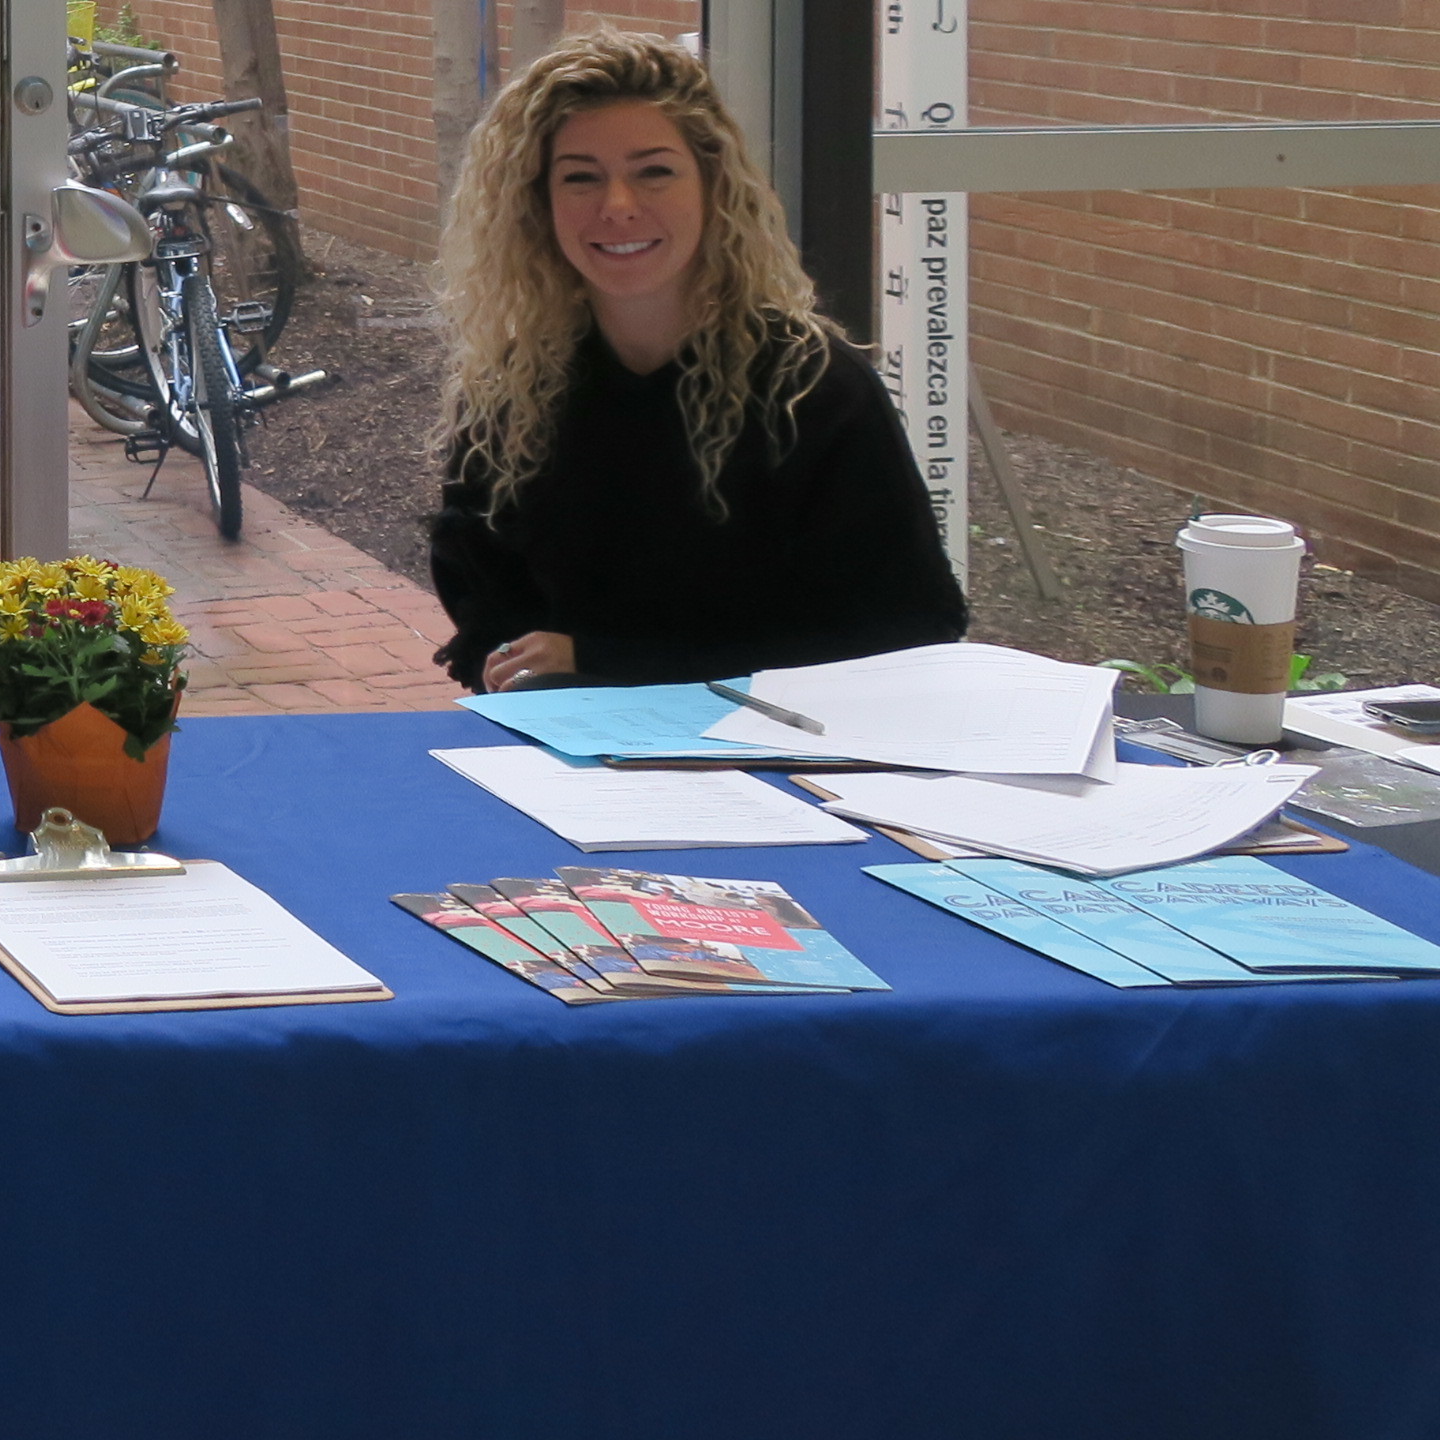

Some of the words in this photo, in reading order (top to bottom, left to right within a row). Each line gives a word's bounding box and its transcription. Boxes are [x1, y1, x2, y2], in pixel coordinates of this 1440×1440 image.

[921, 197, 949, 248] paz
[921, 256, 954, 406] prevalezca
[928, 415, 949, 448] en
[928, 456, 955, 480] la
[929, 487, 956, 546] tier
[653, 918, 772, 937] MOORE
